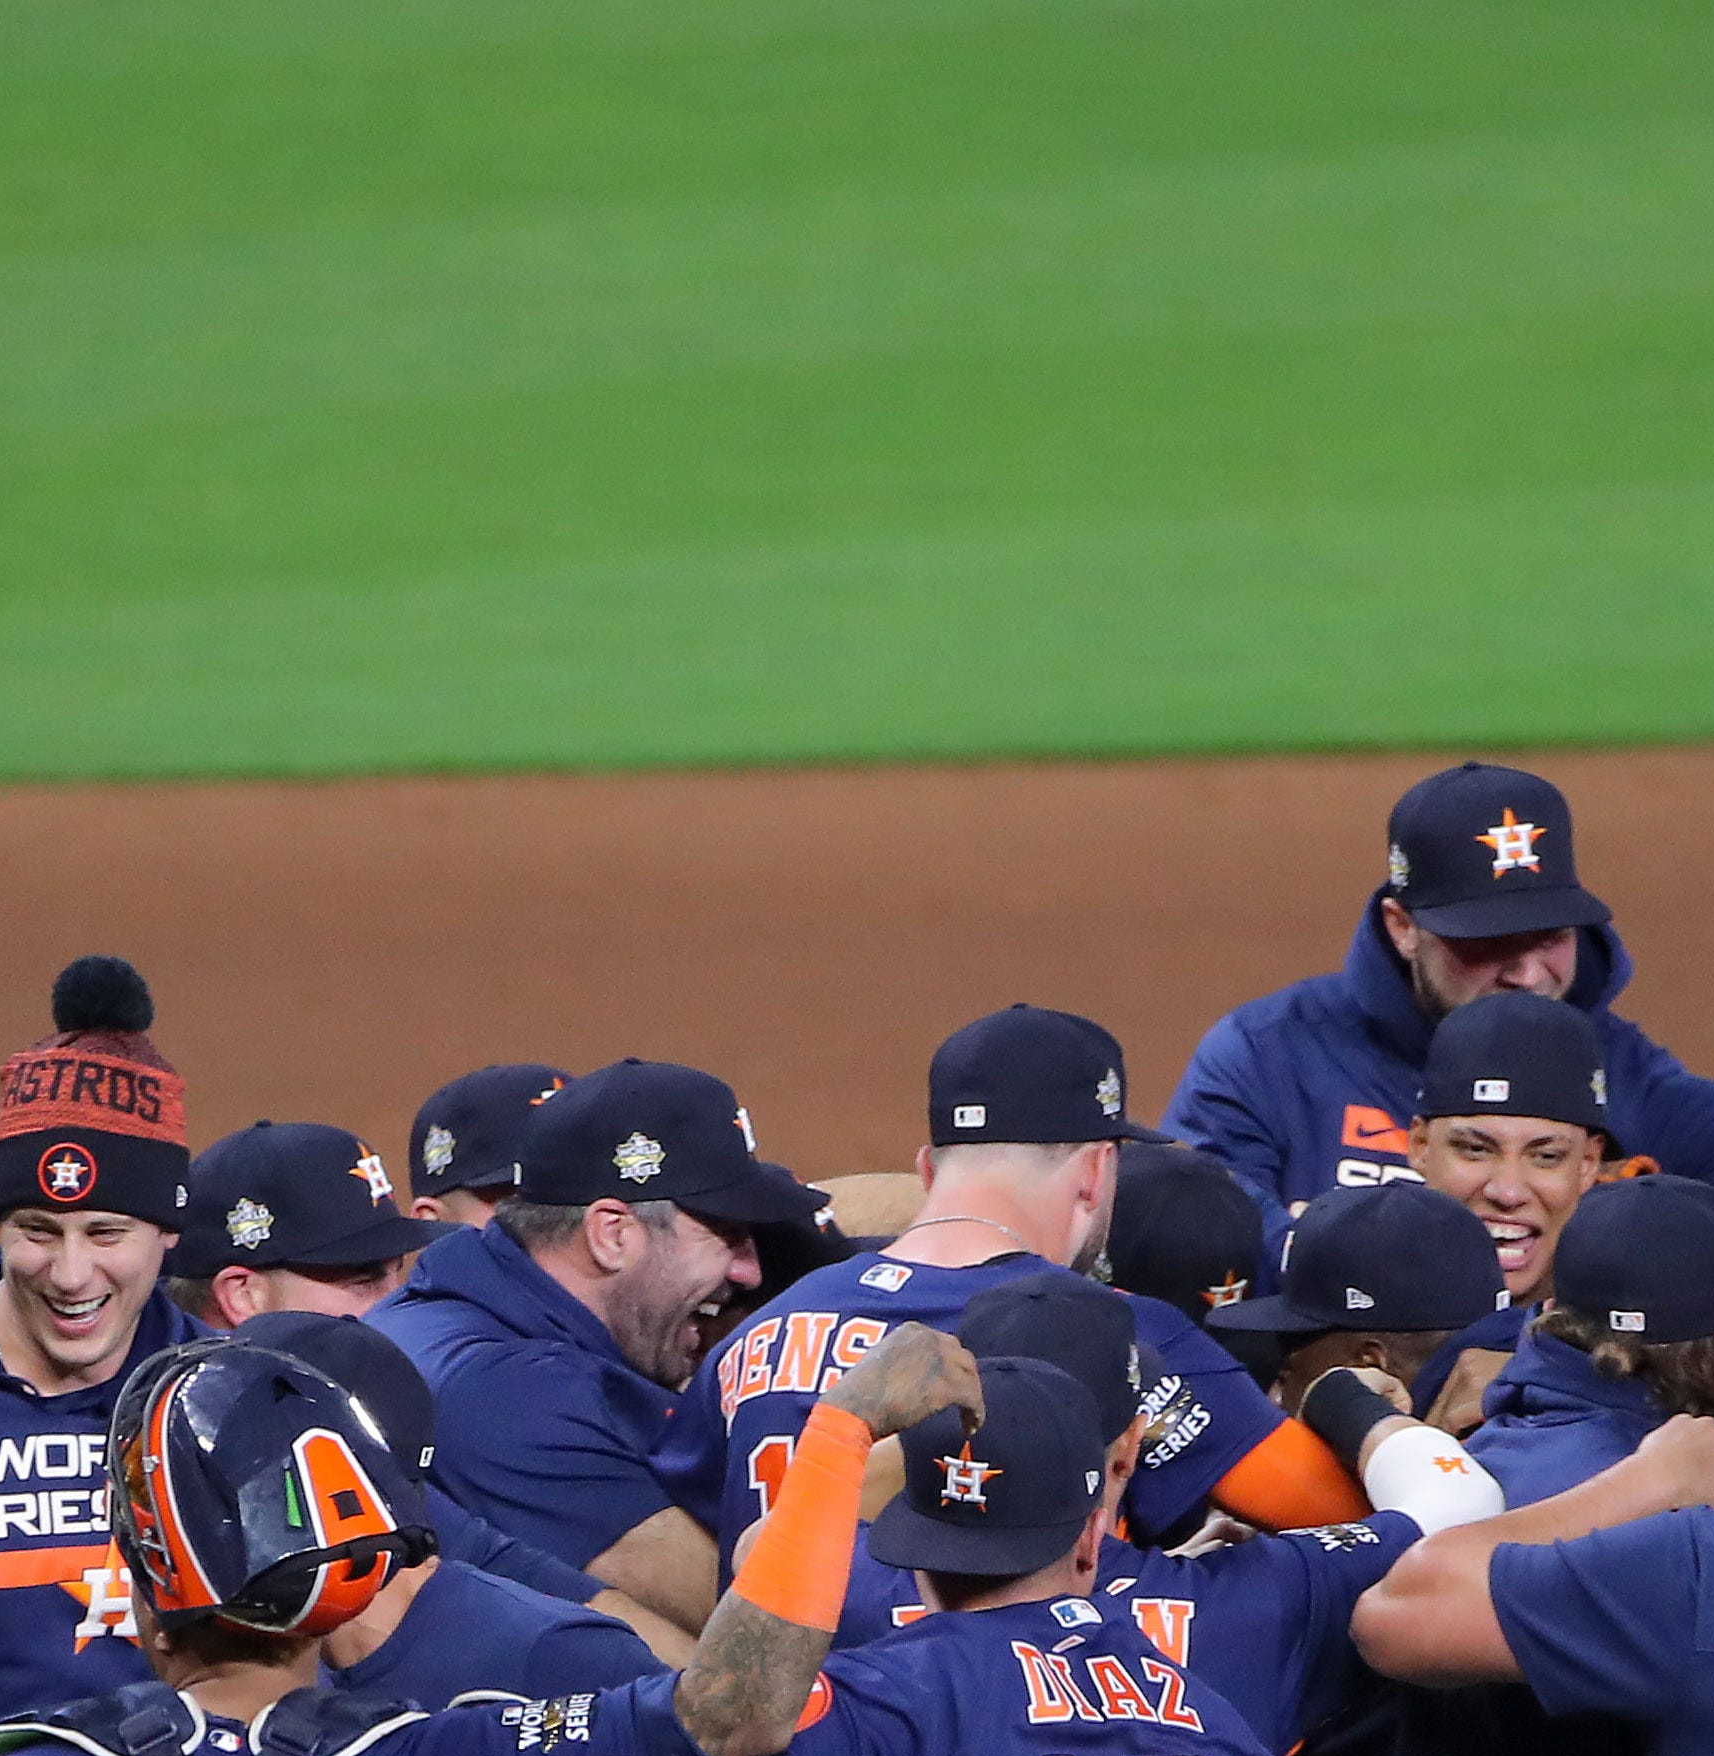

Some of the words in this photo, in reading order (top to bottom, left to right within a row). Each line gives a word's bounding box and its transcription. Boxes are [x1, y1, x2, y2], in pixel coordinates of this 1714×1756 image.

[1488, 823, 1540, 870] H
[1144, 1403, 1211, 1469] SERIES
[941, 1455, 989, 1503] H
[1011, 1634, 1205, 1734] DÍAZ
